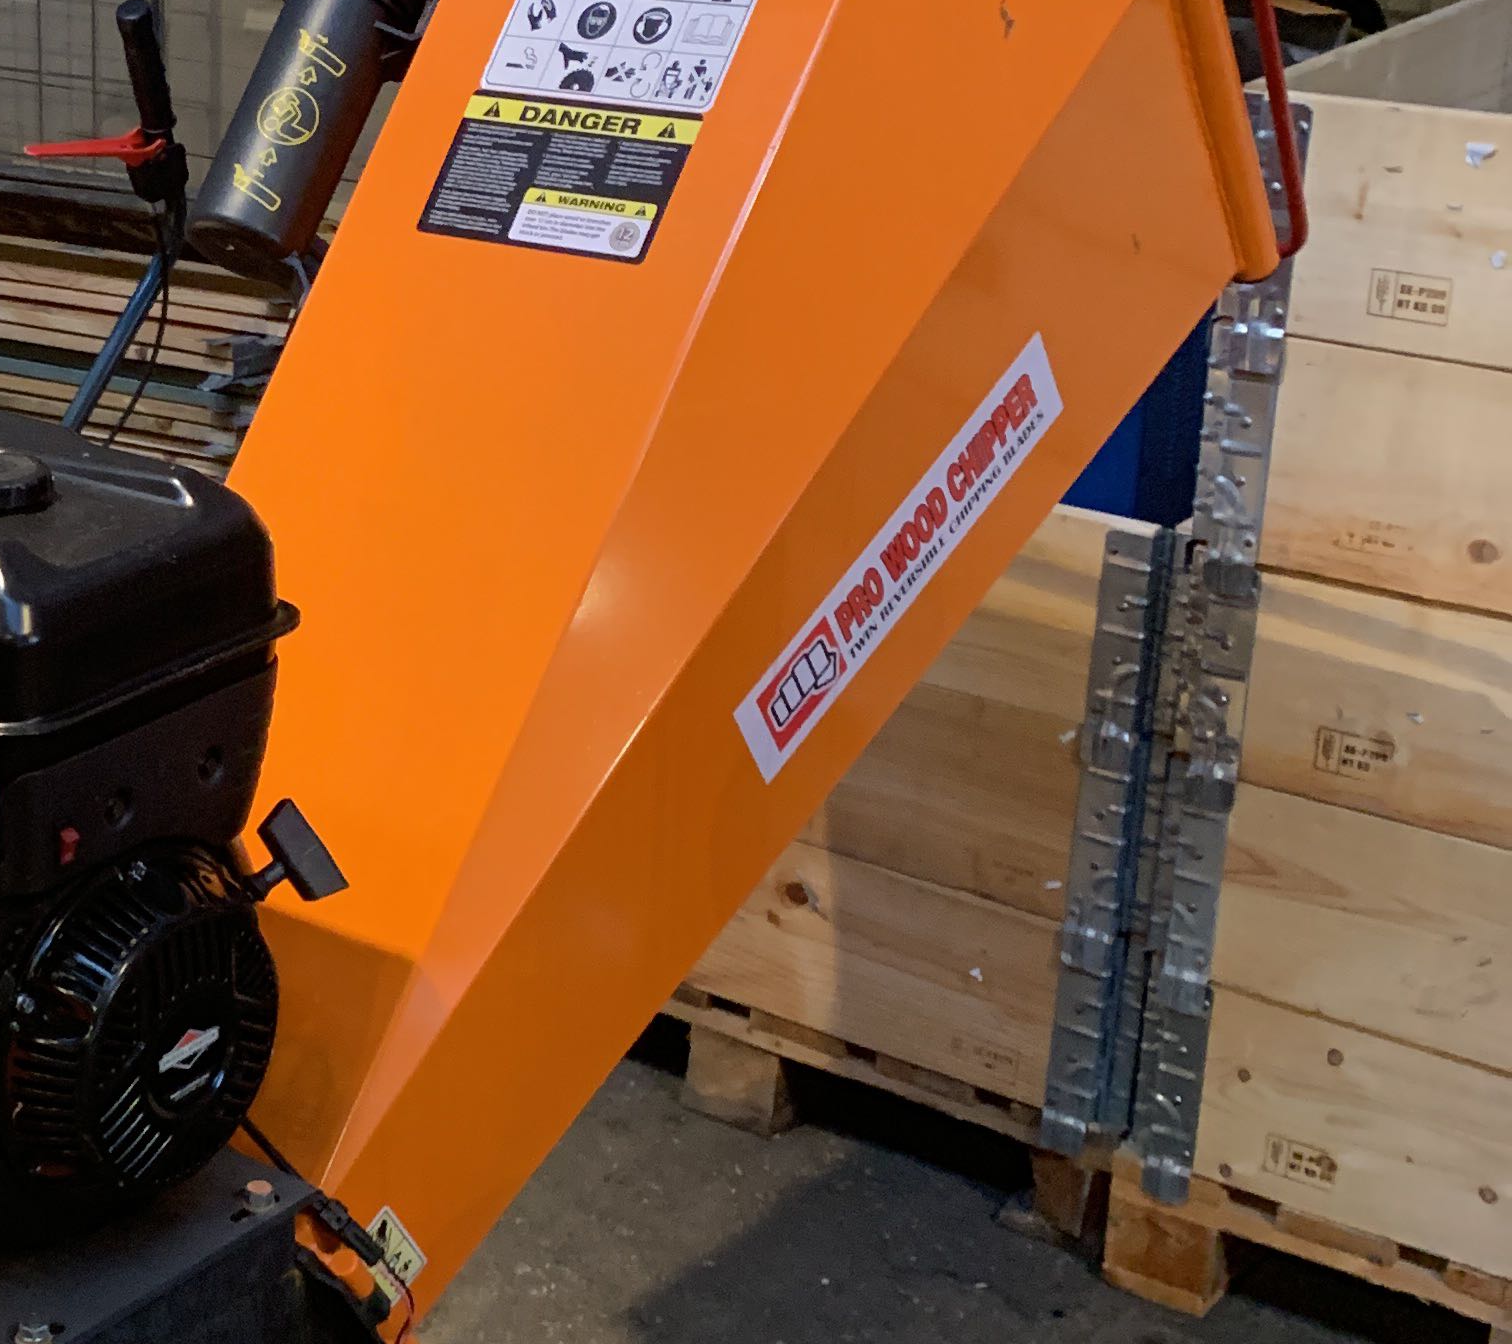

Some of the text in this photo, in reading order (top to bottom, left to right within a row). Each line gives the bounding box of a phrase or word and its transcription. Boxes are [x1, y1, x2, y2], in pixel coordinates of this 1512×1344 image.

[518, 104, 642, 136] DANGER
[558, 195, 627, 213] WARNING
[833, 372, 1039, 643] PRO WOOD CHIPPER
[949, 465, 1003, 536] CHIPPING
